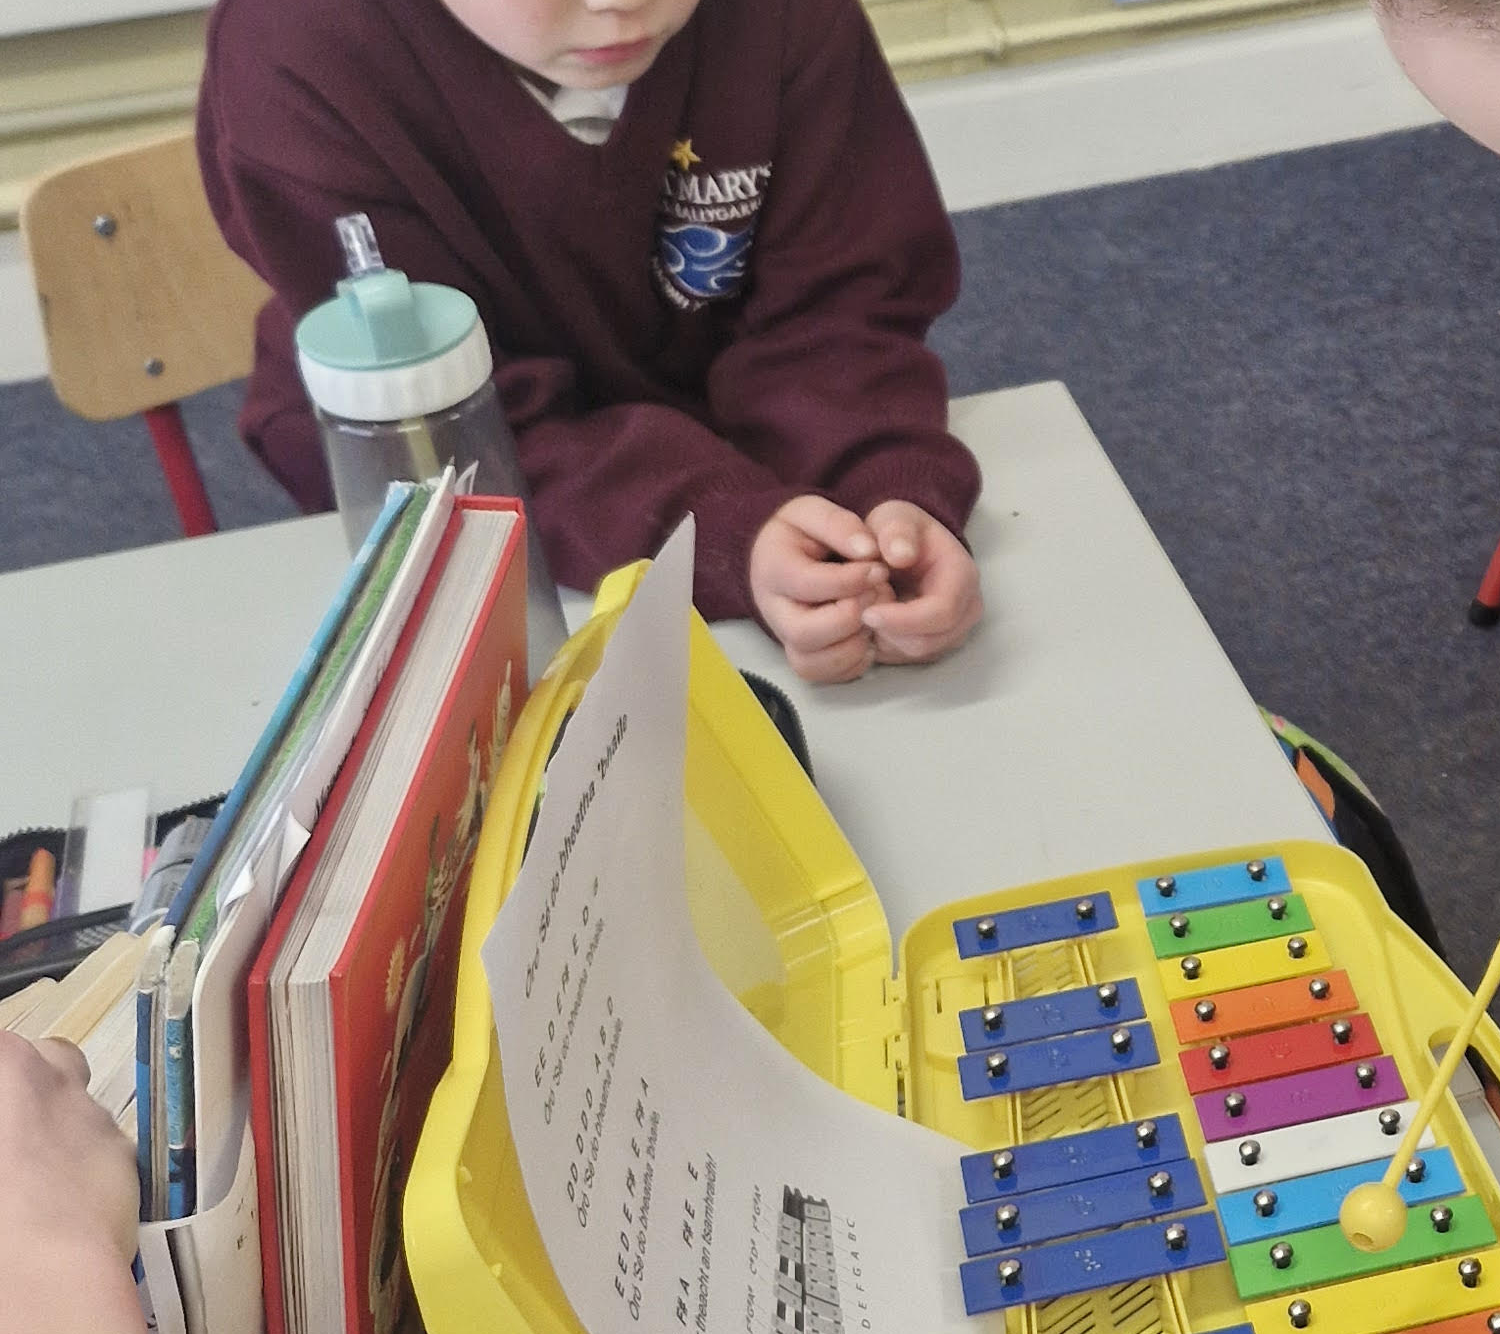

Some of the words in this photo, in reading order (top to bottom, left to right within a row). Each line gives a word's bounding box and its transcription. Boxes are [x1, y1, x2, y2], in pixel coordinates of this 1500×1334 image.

[558, 780, 596, 875] bheatha
[548, 1020, 555, 1043] D
[640, 1077, 649, 1098] A
[575, 1132, 584, 1155] D
[581, 1109, 588, 1132] D
[586, 1087, 593, 1110] D
[594, 1052, 601, 1075] A
[591, 1136, 599, 1162] do
[631, 1137, 640, 1159] E
[626, 1167, 636, 1198] F#
[687, 1161, 698, 1182] E
[685, 1199, 695, 1221] E
[701, 1152, 718, 1248] tsamhraidh!
[624, 1202, 633, 1225] E
[846, 1218, 856, 1229] C
[620, 1230, 630, 1253] D
[635, 1229, 648, 1255] do
[682, 1220, 694, 1249] F#
[847, 1232, 857, 1242] B
[618, 1252, 628, 1276] E
[702, 1245, 711, 1269] an
[850, 1250, 860, 1261] A
[852, 1265, 862, 1277] G
[614, 1275, 625, 1300] E
[679, 1277, 690, 1297] A
[855, 1283, 865, 1293] F
[628, 1284, 643, 1322] Óró
[676, 1296, 688, 1327] F#
[697, 1267, 711, 1334] theacht
[858, 1300, 868, 1311] E
[861, 1318, 872, 1330] D
